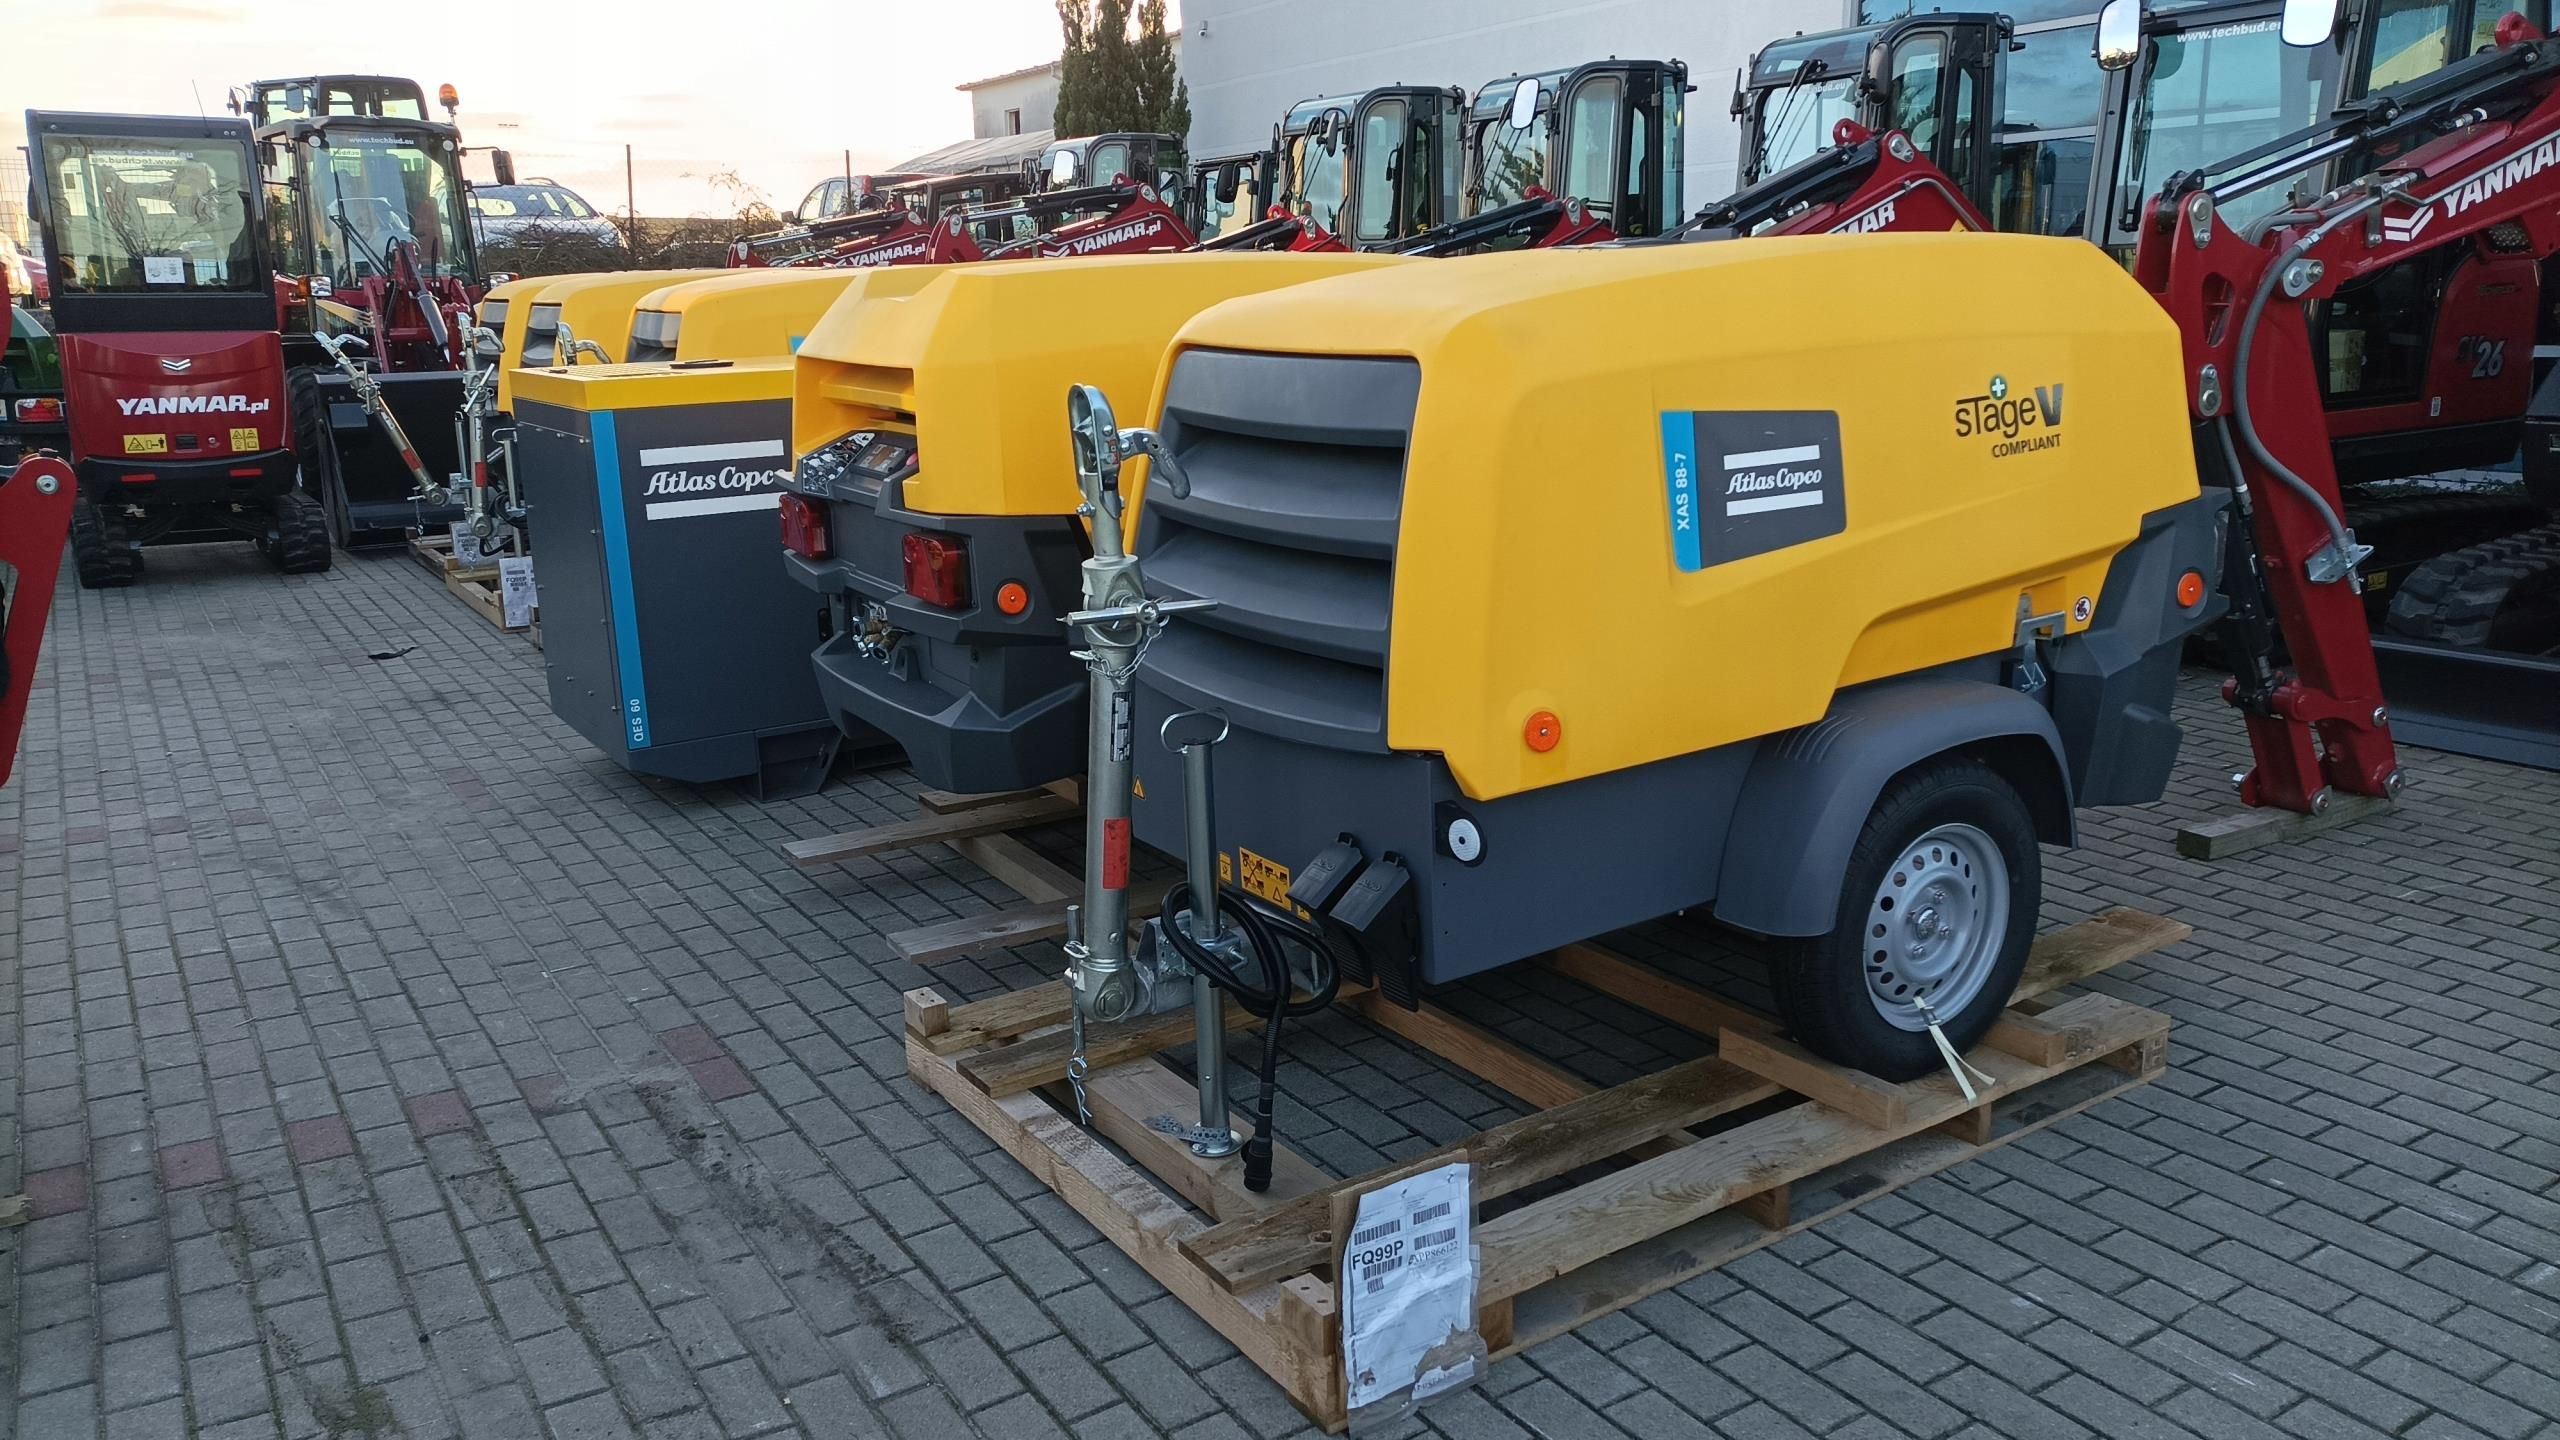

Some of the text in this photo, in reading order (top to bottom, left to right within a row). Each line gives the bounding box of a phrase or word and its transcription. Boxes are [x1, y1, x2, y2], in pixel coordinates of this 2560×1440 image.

[1073, 219, 1161, 254] YANMAR.pl
[849, 242, 926, 266] YANMAR.pl
[116, 394, 270, 415] YANMAR.pl
[1991, 433, 2062, 458] COMPLIANT
[643, 465, 774, 496] Atlas Copc
[1674, 452, 1690, 531] XAS 88-7
[1725, 467, 1823, 495] Atlas Copco
[630, 698, 644, 742] QES 60
[1352, 1240, 1404, 1270] FQ99P
